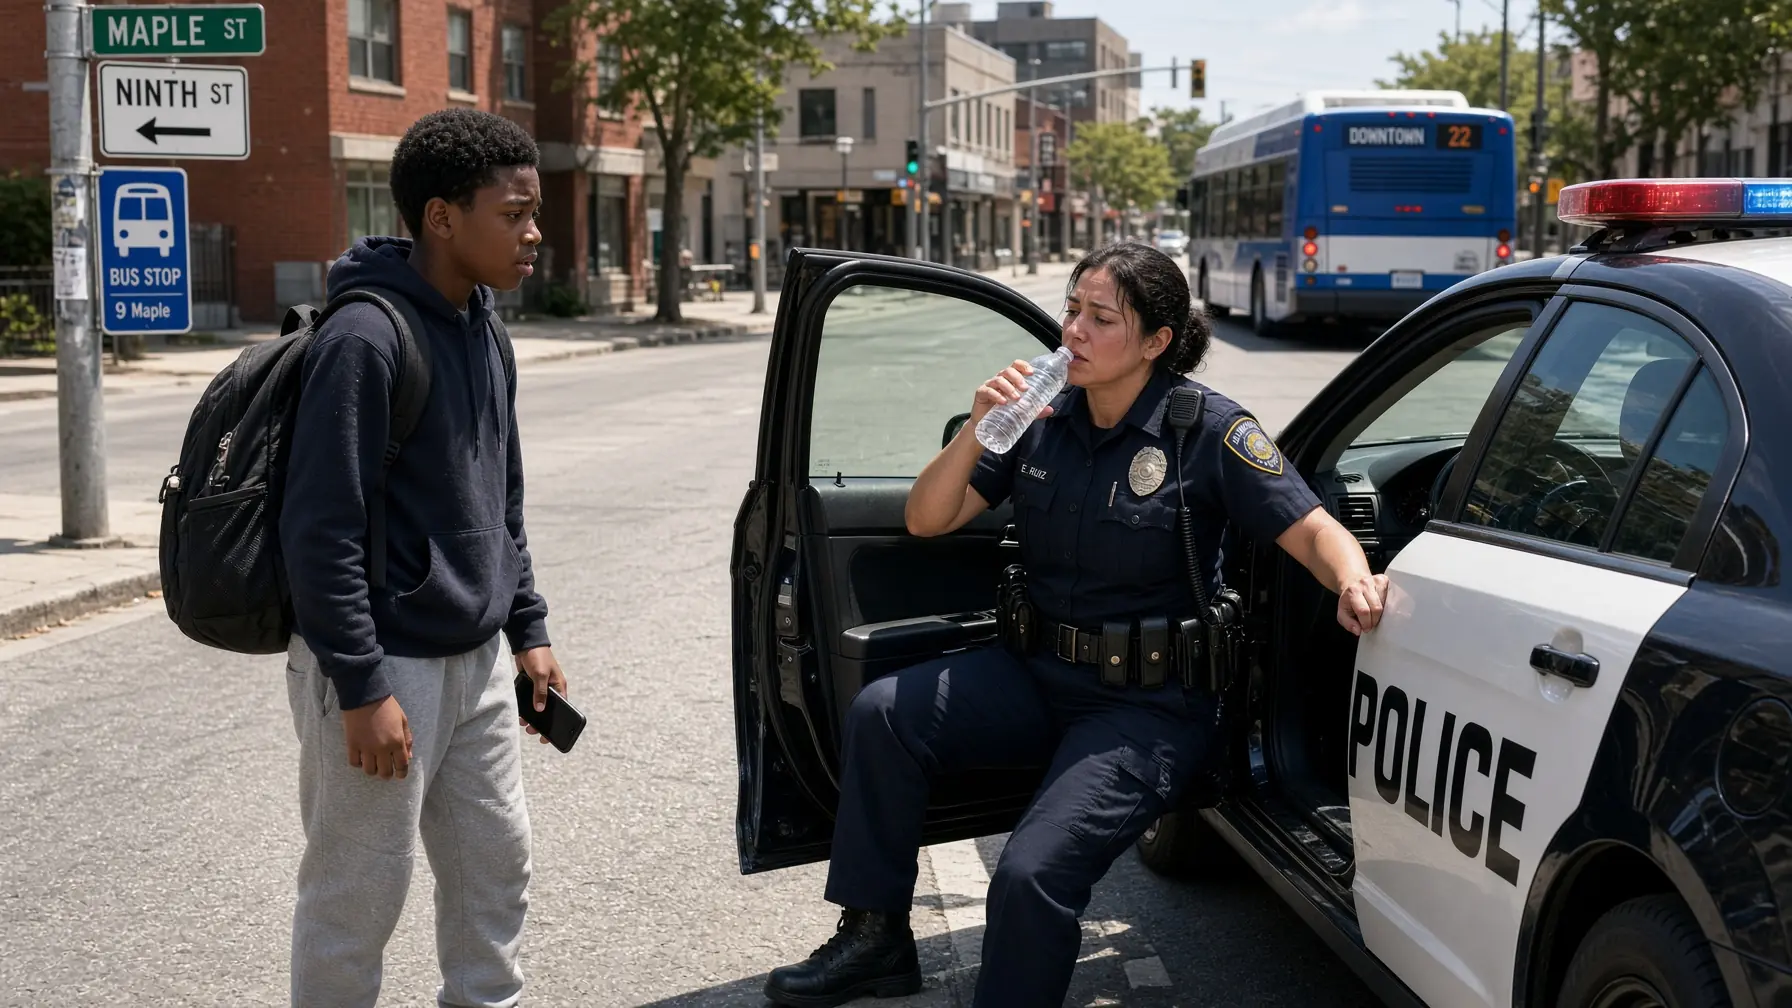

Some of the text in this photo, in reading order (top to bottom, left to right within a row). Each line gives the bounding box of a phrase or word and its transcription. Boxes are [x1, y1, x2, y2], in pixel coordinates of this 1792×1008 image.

[108, 15, 247, 47] MAPLE ST
[116, 78, 233, 108] NINTH ST
[1349, 127, 1425, 145] DOWNTOWN
[1448, 126, 1471, 148] 22
[109, 267, 182, 286] BUS STOP
[115, 301, 171, 322] 9 Maple
[1028, 466, 1047, 480] RUIZ
[1349, 669, 1537, 887] POLICE
